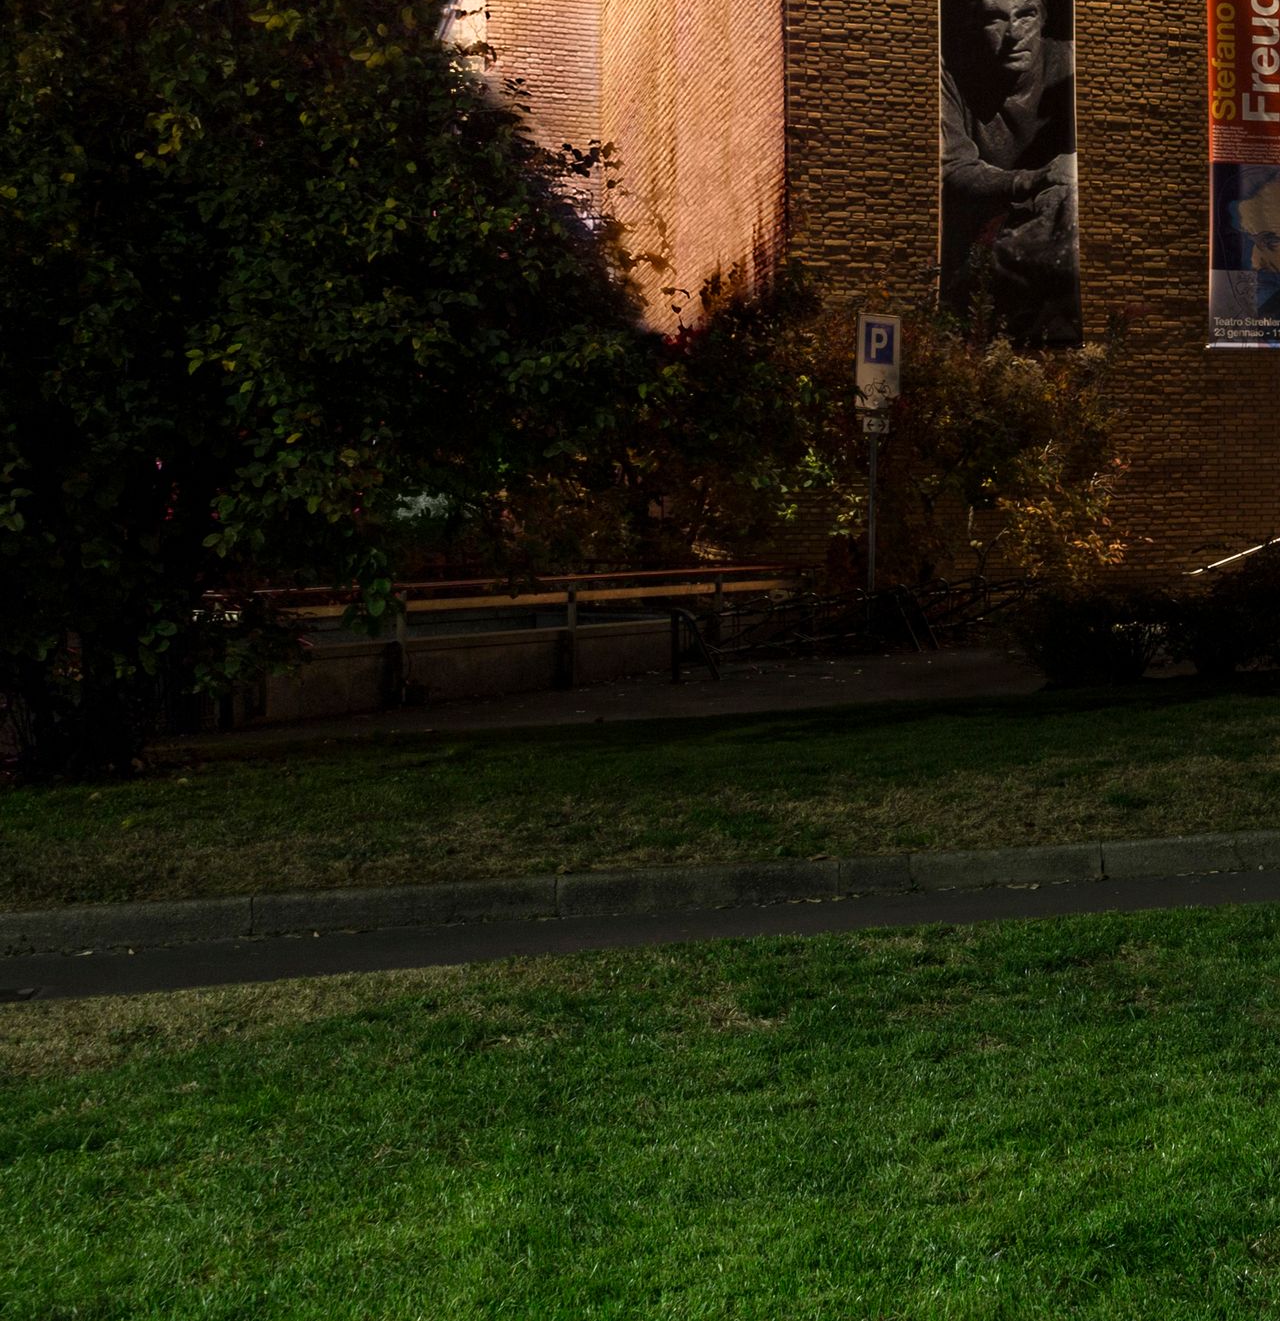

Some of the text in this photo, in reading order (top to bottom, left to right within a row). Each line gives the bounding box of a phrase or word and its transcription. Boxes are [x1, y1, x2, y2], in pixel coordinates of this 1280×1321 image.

[1211, 2, 1237, 120] Stefano
[1213, 316, 1280, 327] Teatro Strehler
[870, 327, 888, 359] P
[1214, 328, 1225, 337] 23
[1227, 328, 1264, 338] gennaio
